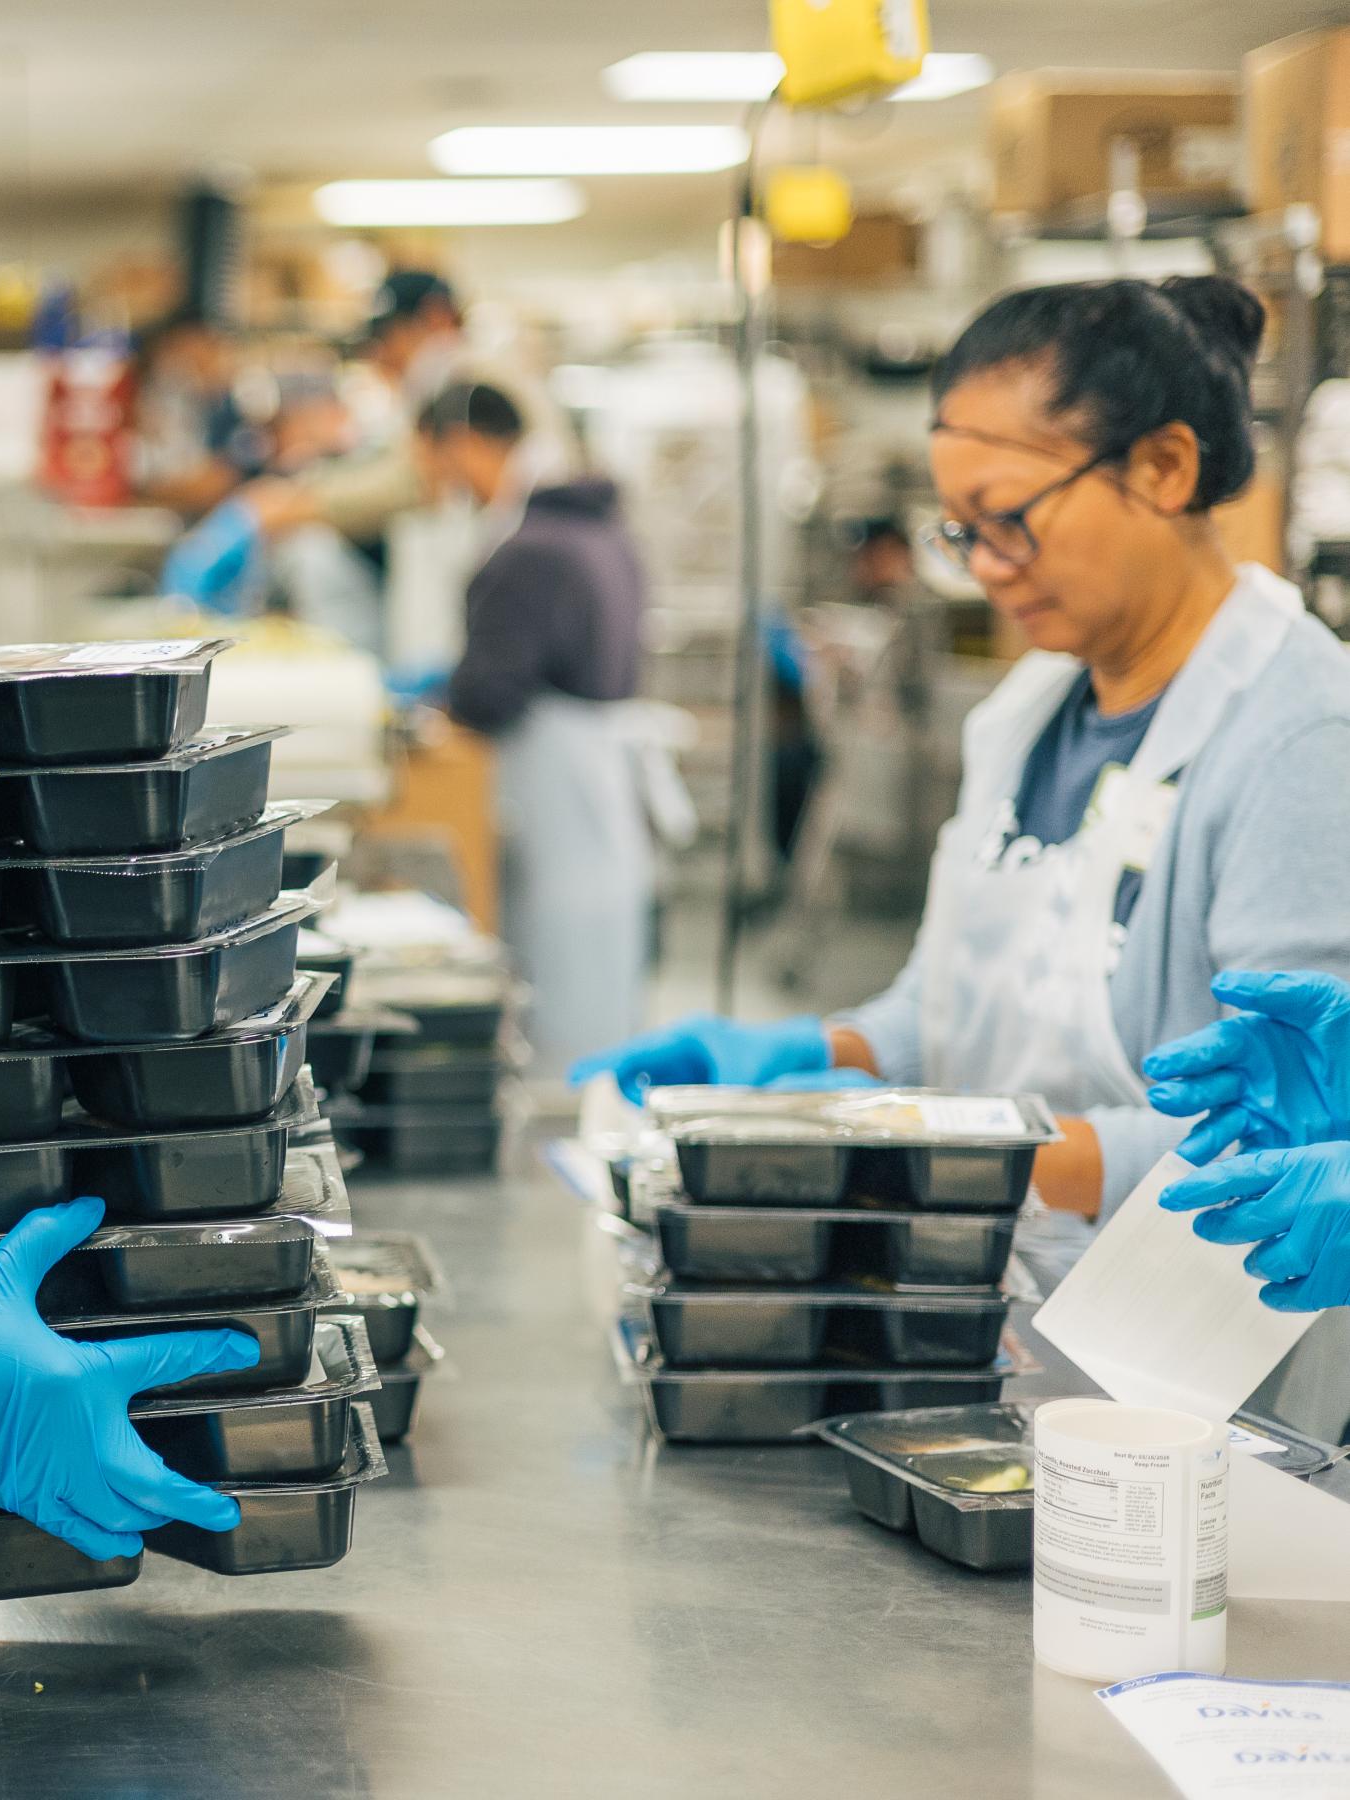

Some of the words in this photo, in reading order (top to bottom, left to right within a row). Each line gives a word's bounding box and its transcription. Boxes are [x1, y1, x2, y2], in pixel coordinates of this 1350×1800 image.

[1059, 1459, 1081, 1471] Roasted
[1082, 1466, 1111, 1476] Zucchini
[1201, 1491, 1216, 1500] Facts
[1197, 1701, 1324, 1721] DaVita
